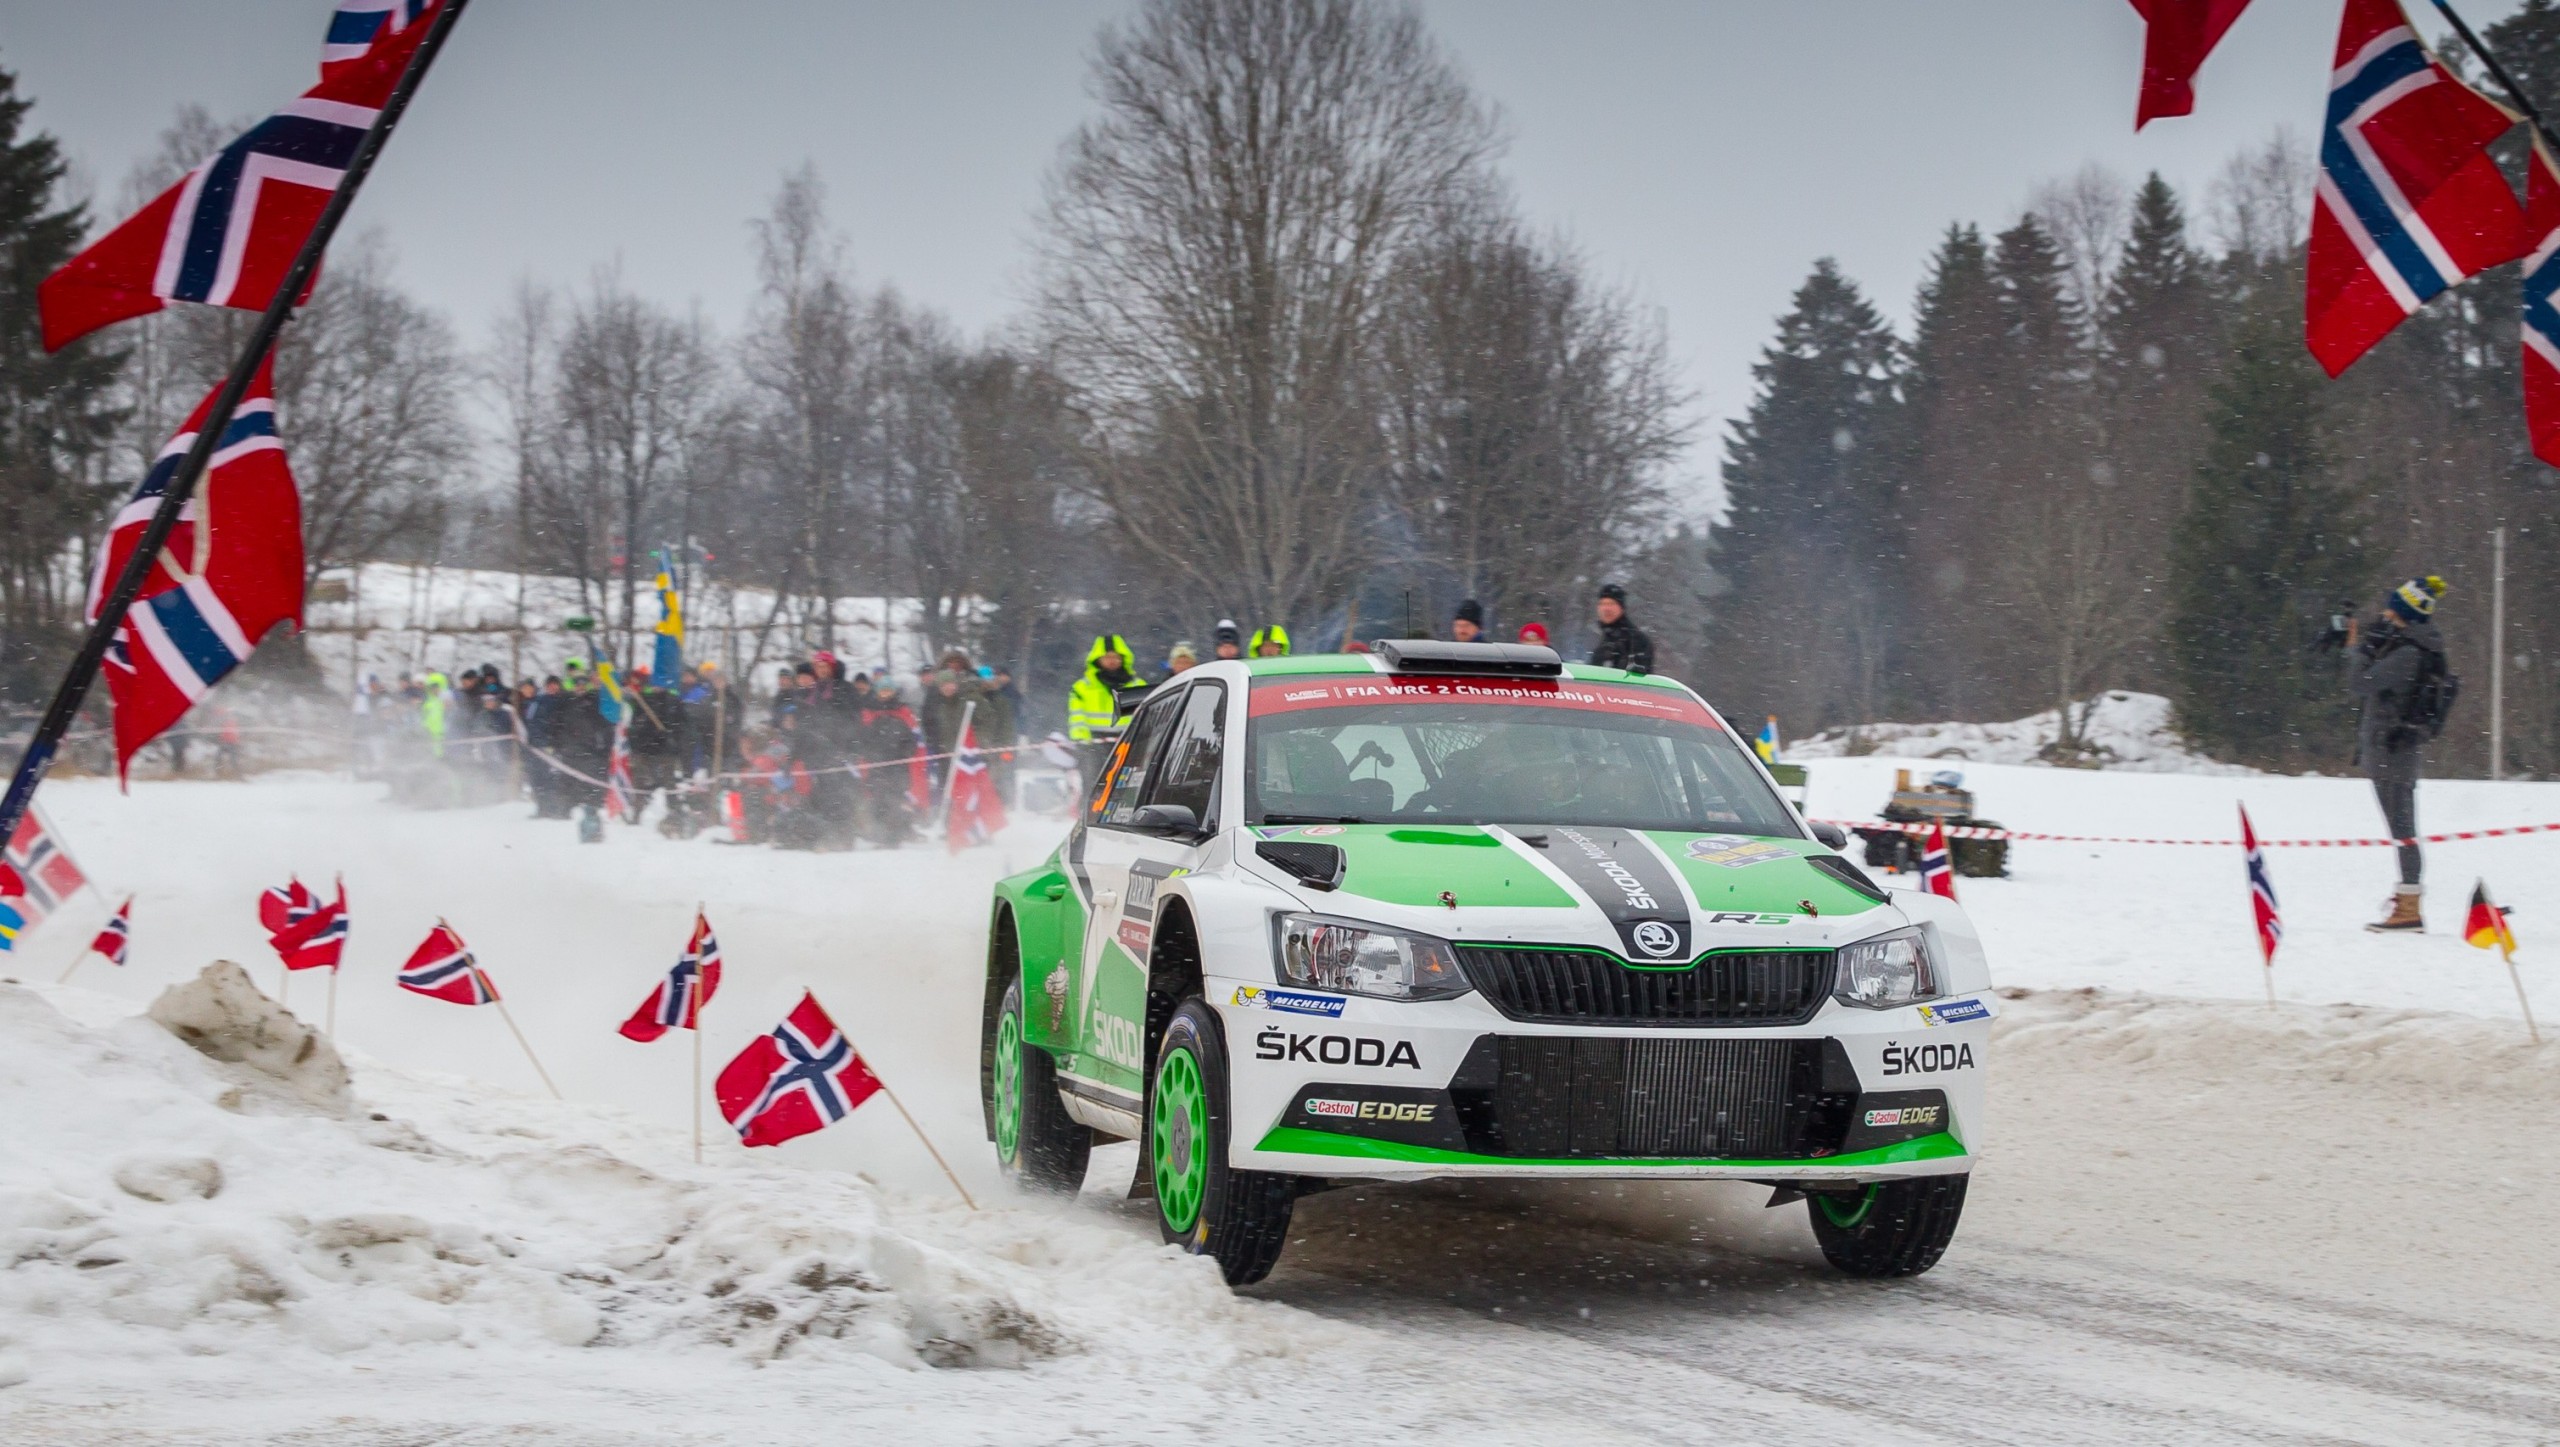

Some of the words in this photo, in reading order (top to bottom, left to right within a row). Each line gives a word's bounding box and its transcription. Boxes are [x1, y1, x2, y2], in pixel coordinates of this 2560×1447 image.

[1345, 686, 1380, 697] FIA
[1384, 685, 1431, 695] WRC
[1436, 685, 1450, 695] 2
[1456, 685, 1595, 703] Championship
[1091, 741, 1132, 813] 3
[1597, 861, 1660, 910] ŠKODA
[1709, 912, 1794, 925] R5
[1273, 996, 1345, 1011] MICHELIN
[1941, 1003, 1985, 1018] MICHELIN
[1255, 1025, 1422, 1070] ŠKODA
[1882, 1041, 1975, 1076] ŠKODA
[1318, 1101, 1355, 1115] Castrol
[1358, 1101, 1439, 1122] EDGE
[1874, 1110, 1899, 1124] Castrol
[1900, 1105, 1941, 1125] EDGE
